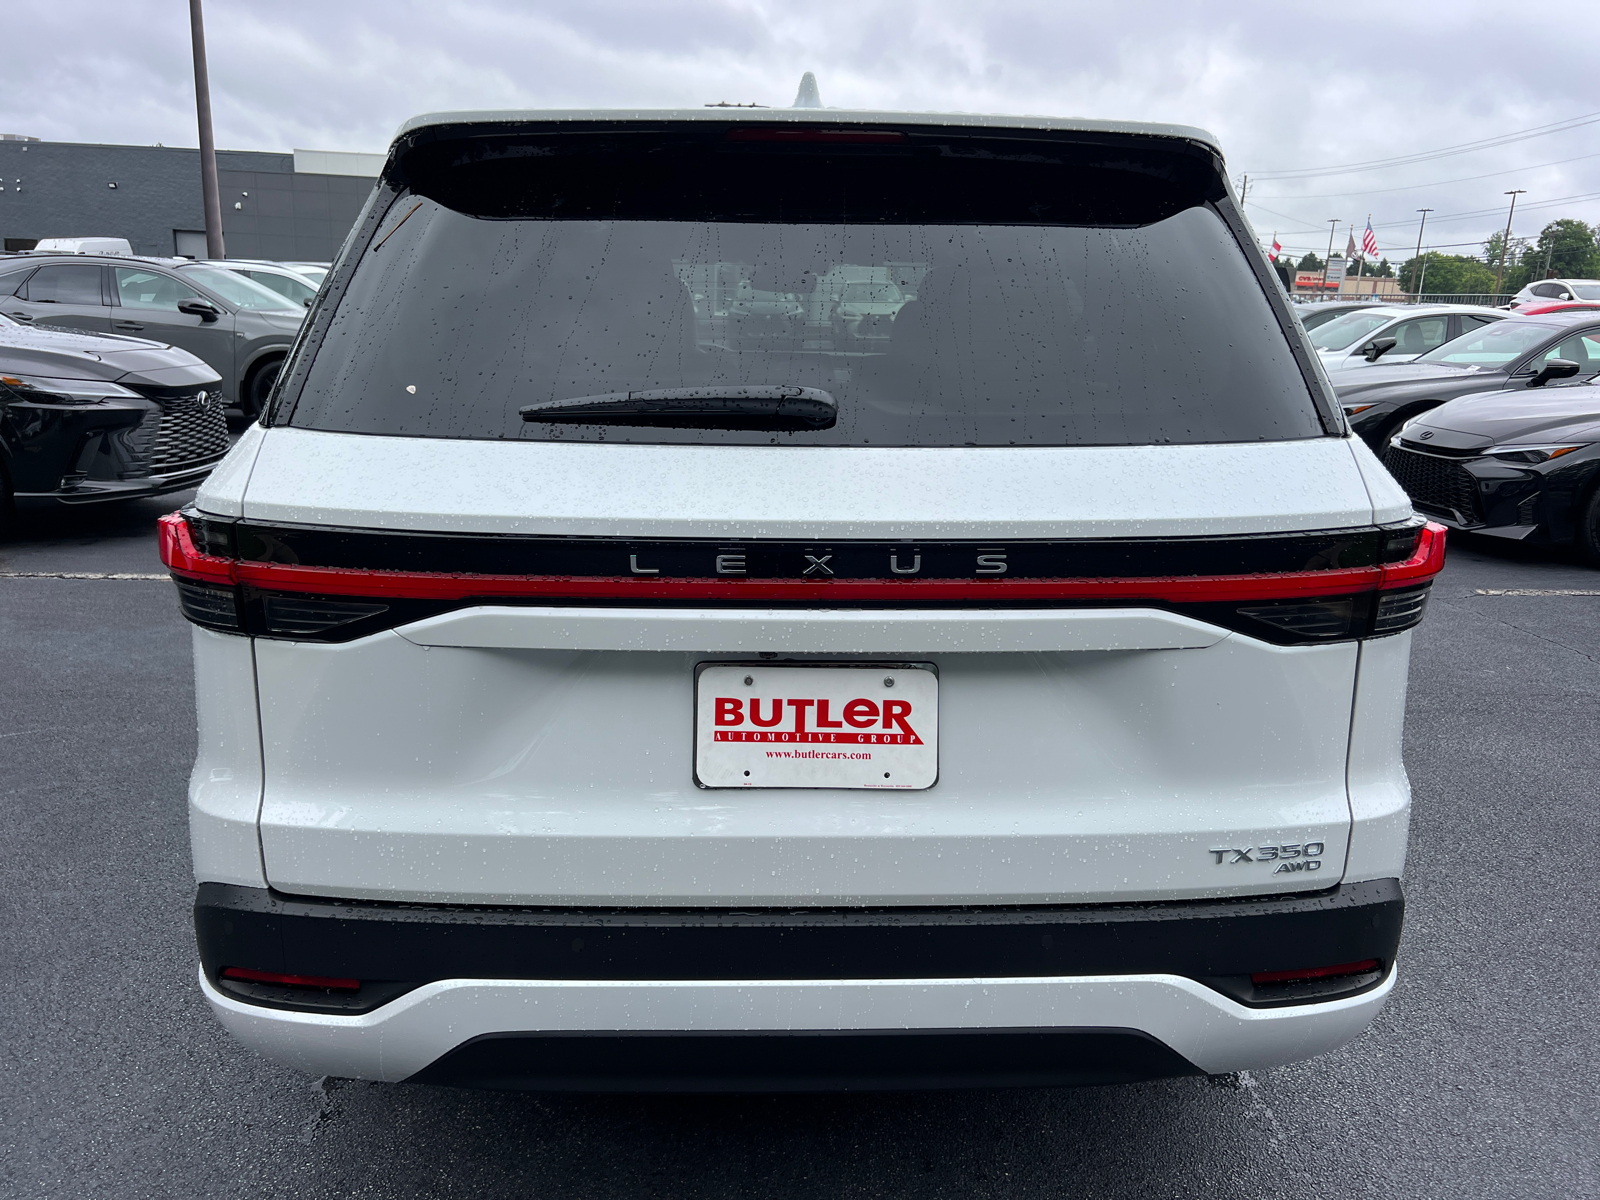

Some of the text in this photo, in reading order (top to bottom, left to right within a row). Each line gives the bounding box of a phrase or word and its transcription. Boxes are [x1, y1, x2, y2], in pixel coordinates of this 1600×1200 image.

[630, 554, 1008, 574] LEXUS
[715, 732, 917, 744] AUTOMOTIVE GROUP
[766, 750, 872, 760] www.butlercars.com
[1273, 860, 1321, 874] AWD
